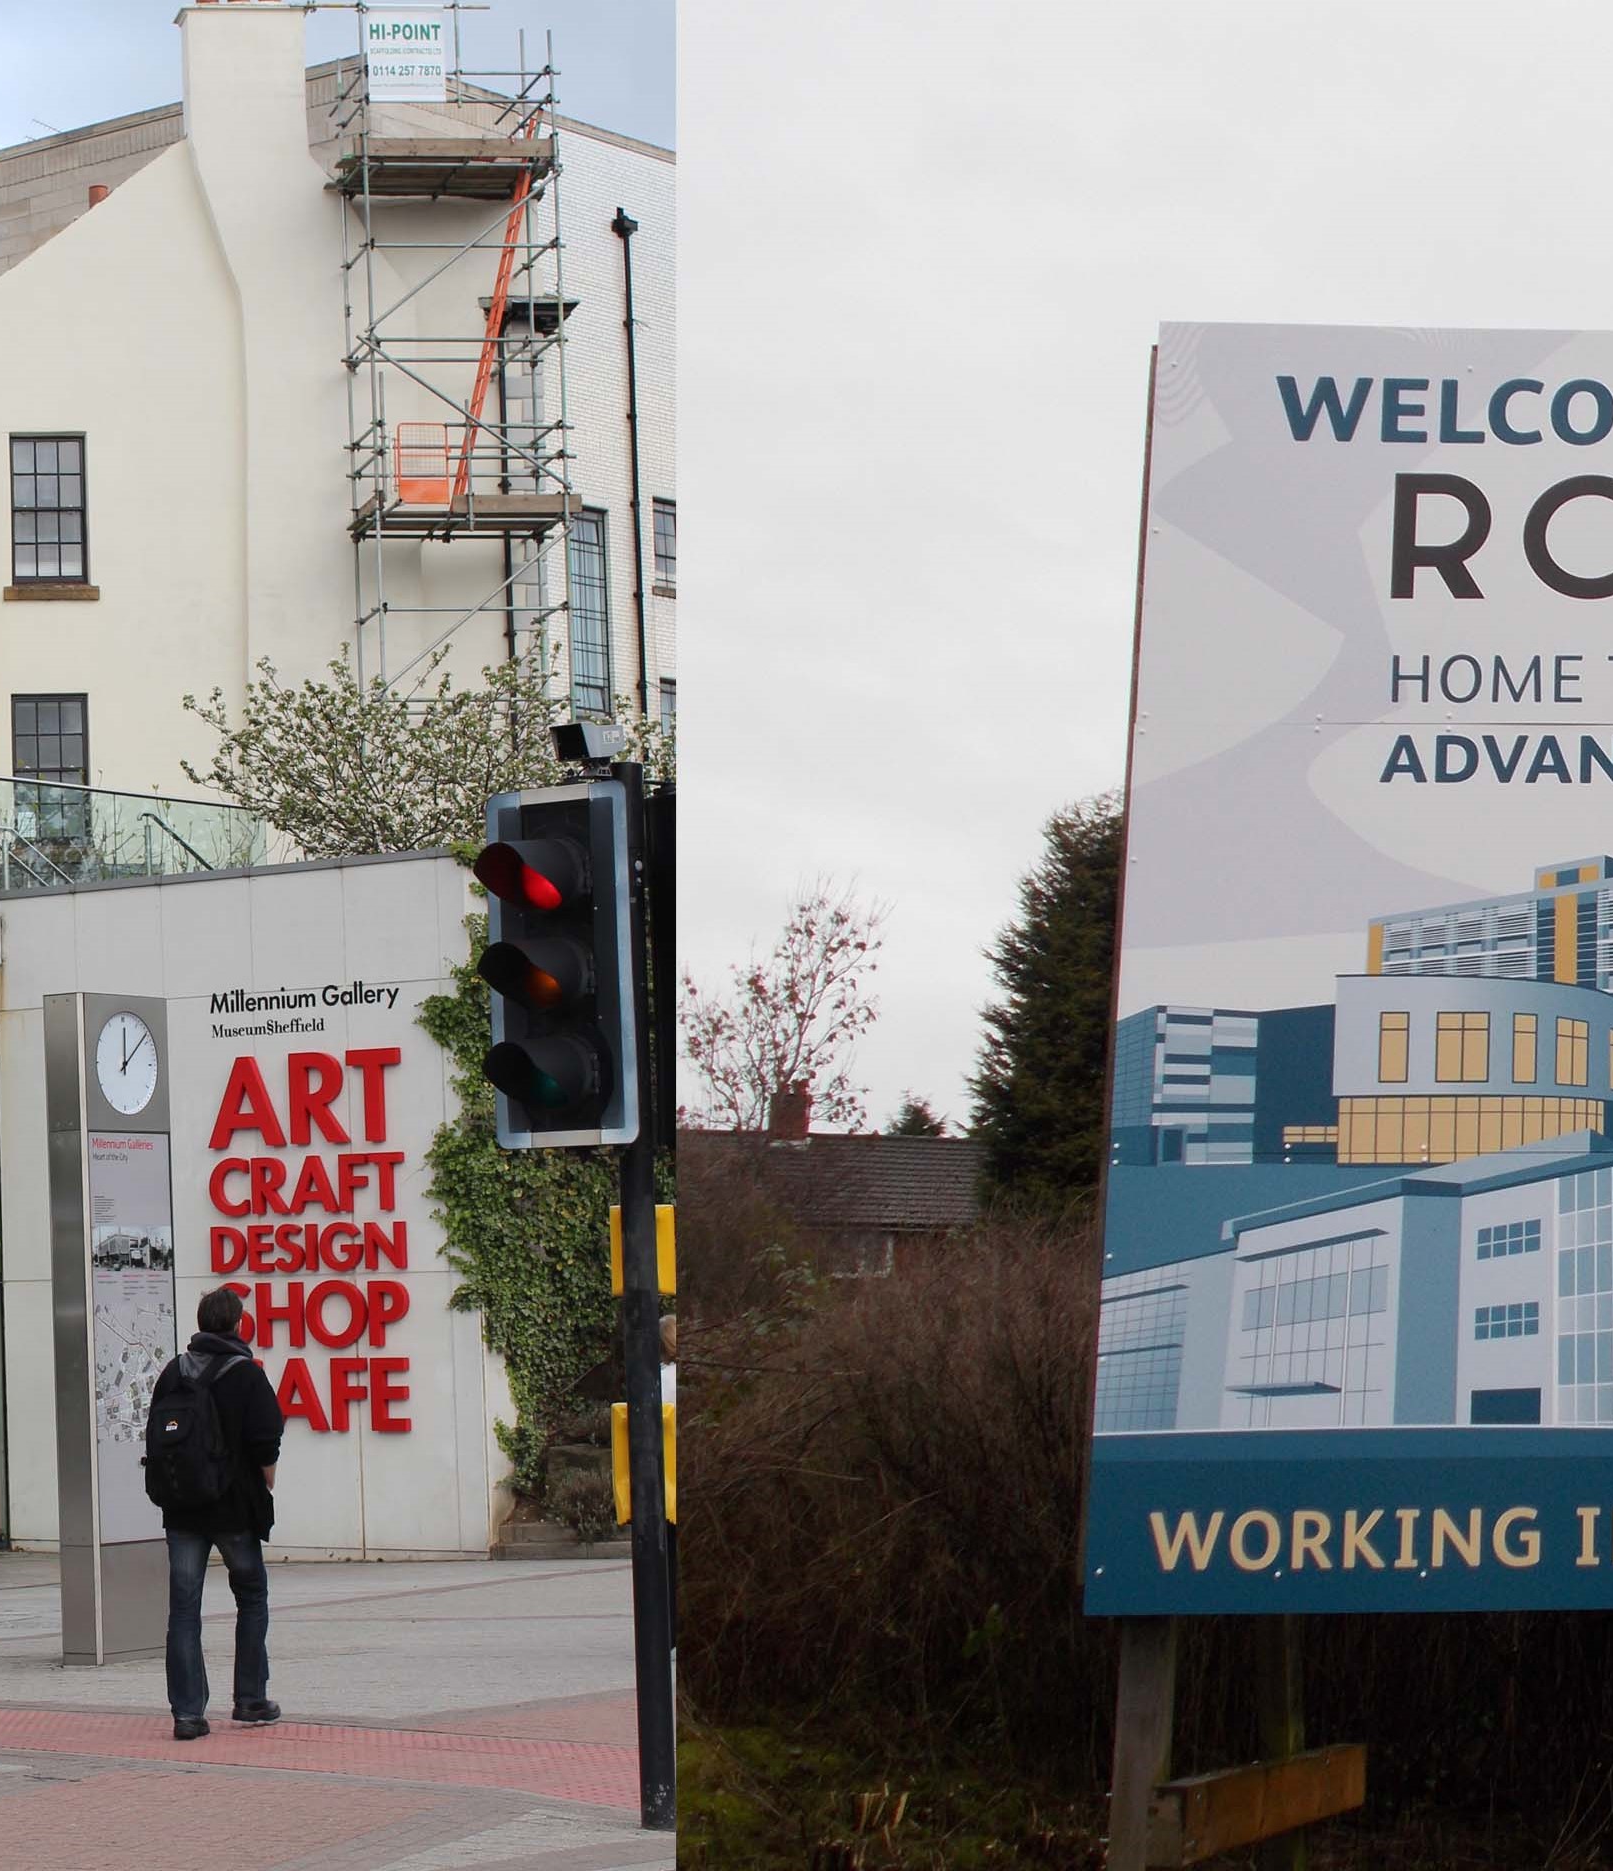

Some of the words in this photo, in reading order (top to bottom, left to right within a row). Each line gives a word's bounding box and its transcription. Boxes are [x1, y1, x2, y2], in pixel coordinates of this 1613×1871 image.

[369, 24, 441, 40] HI-POINT
[373, 65, 396, 76] 0114
[398, 65, 416, 76] 257
[418, 65, 442, 76] 7870
[1390, 653, 1585, 704] HOME
[210, 986, 316, 1014] Millennium
[321, 980, 400, 1009] Gallery
[209, 1047, 401, 1149] ART
[209, 1152, 404, 1218] CRAFT
[209, 1221, 408, 1274] DESIGN
[253, 1357, 412, 1432] AFE
[1149, 1506, 1542, 1572] WORKING
